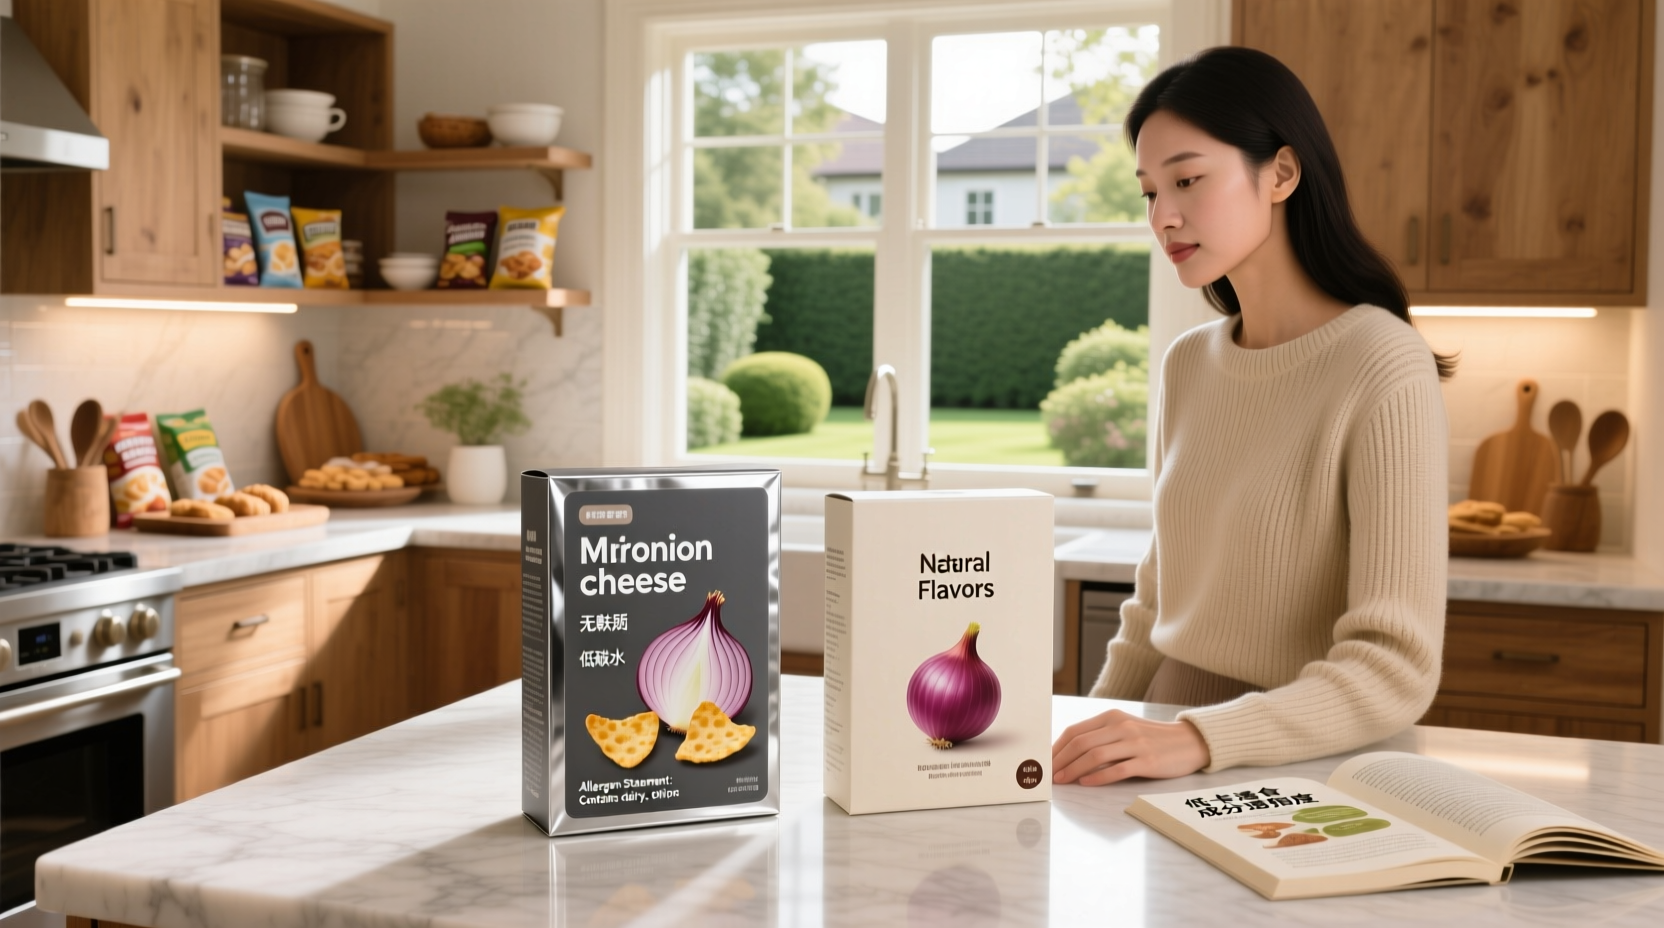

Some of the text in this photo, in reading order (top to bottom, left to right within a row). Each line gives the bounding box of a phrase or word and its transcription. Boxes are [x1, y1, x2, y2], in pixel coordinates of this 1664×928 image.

[920, 550, 990, 574] Natural
[580, 567, 687, 596] cheese
[918, 579, 995, 600] Flavors
